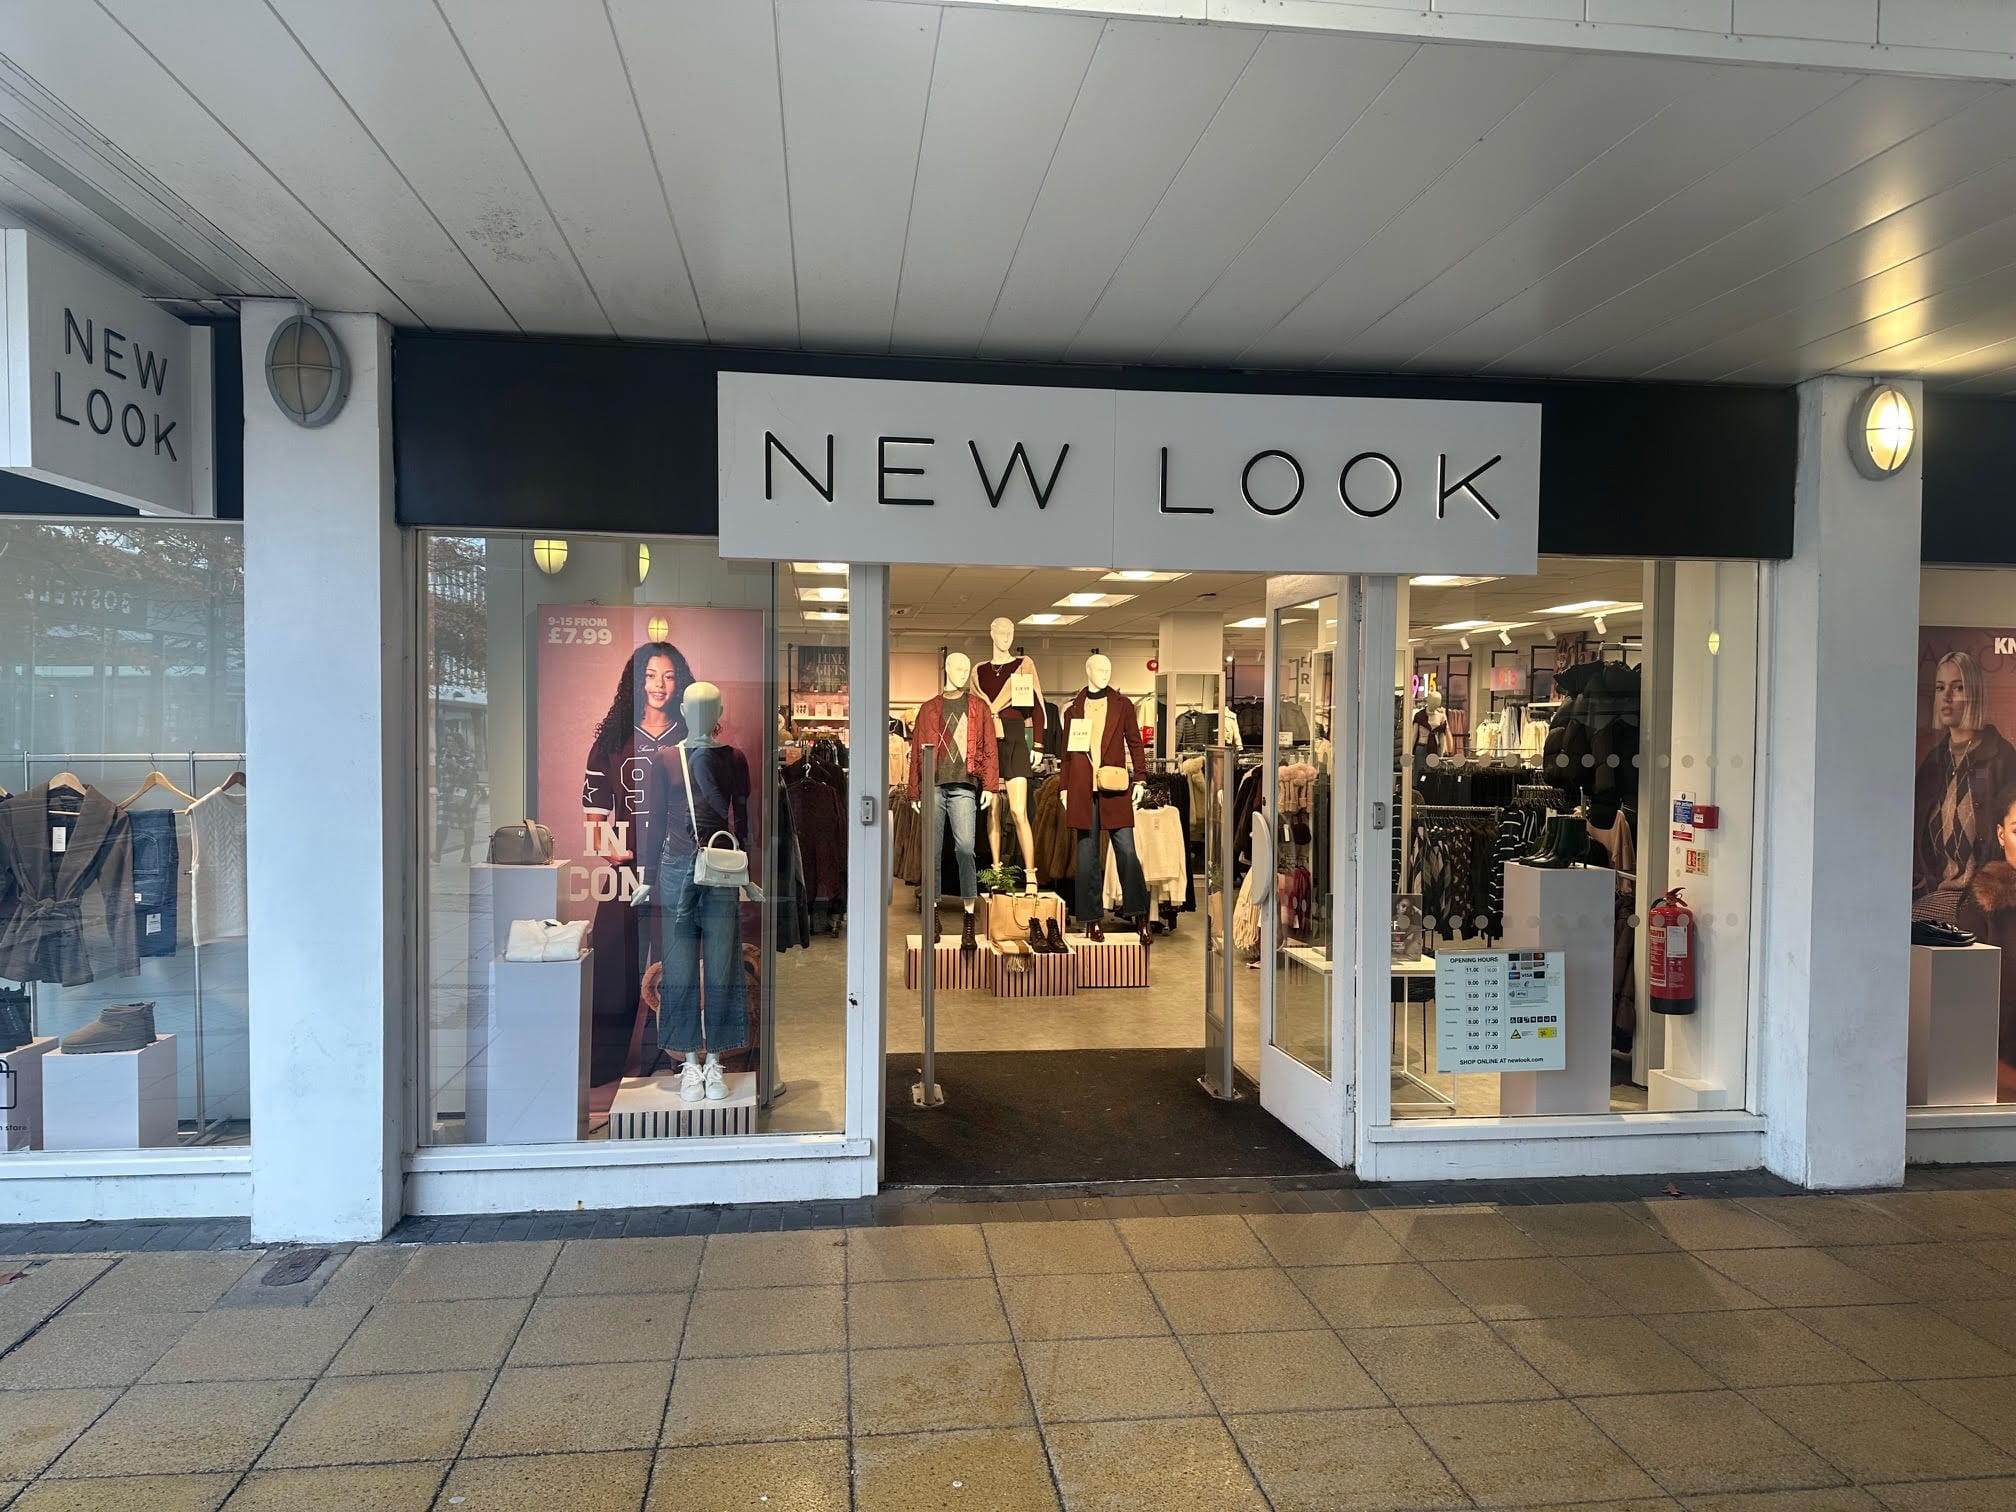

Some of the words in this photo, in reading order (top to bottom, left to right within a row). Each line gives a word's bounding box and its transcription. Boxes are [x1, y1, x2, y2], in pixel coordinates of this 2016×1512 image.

[64, 307, 167, 396] NEW
[54, 371, 177, 462] LOOK
[764, 430, 1070, 509] NEW
[1160, 445, 1503, 521] LOOK
[547, 628, 612, 645] £7.99
[548, 617, 574, 626] 9-15
[575, 618, 607, 627] FROM
[583, 821, 630, 857] IN
